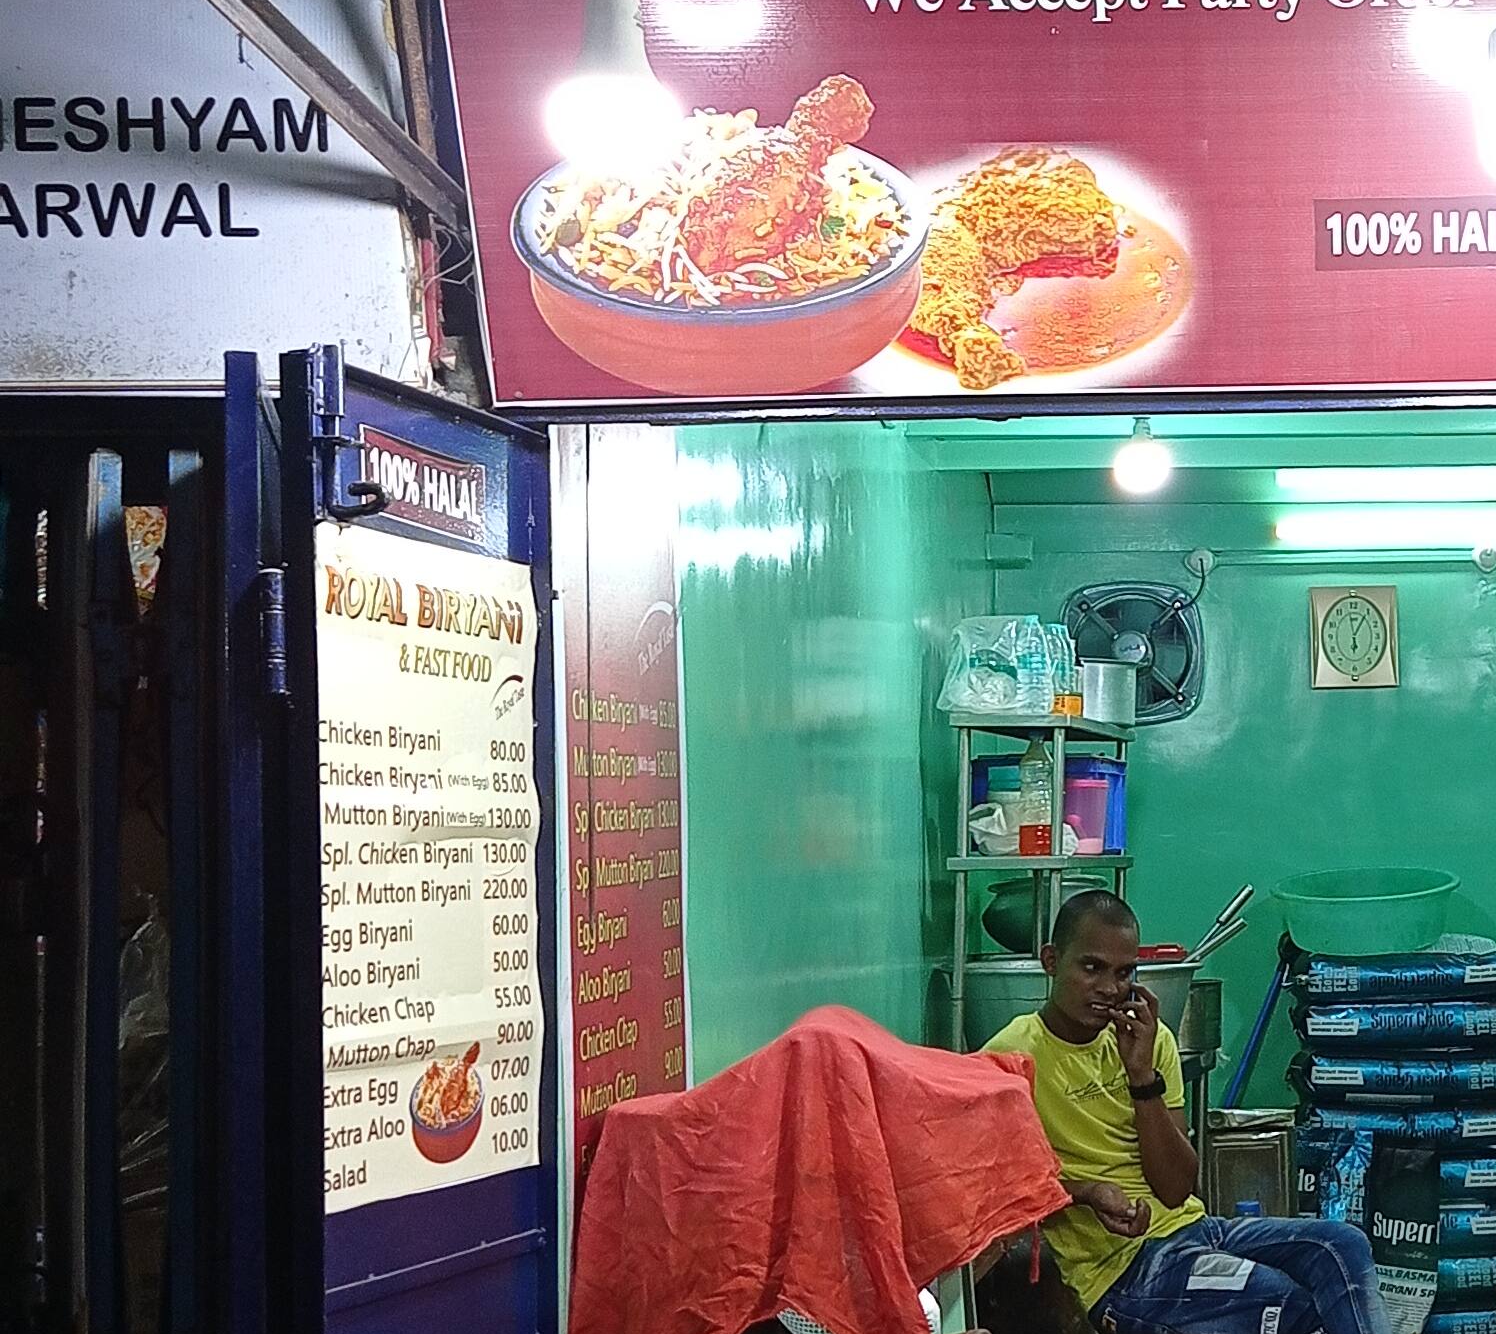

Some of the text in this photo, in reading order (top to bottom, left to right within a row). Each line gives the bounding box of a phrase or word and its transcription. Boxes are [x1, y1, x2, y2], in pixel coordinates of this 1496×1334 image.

[0, 96, 329, 153] ESHYAM
[1325, 210, 1422, 257] 100%
[368, 446, 482, 527] 100% HALAL
[324, 564, 525, 645] ROYAL BIRYANI
[399, 643, 493, 683] & FAST FOOD
[318, 719, 527, 763] Chicken Biryani 80.00
[318, 761, 384, 787] Chicken
[389, 765, 444, 795] Biryani
[491, 771, 528, 794] 85.00
[323, 801, 388, 827] Mutton
[391, 804, 446, 833] Biryani
[487, 807, 532, 829] 130.00
[321, 840, 528, 872] Spl. Chicken Biryani 130.00
[320, 877, 529, 913] Spl. Mutton Biryani 220.00
[321, 913, 529, 954] Egg Biryani 60.00
[322, 948, 530, 990] Aloo Biryani 50.00
[321, 984, 532, 1030] Chicken Chap 55.00
[326, 1019, 534, 1069] Mutton Chap 90.00
[579, 1024, 616, 1062] Chicken
[323, 1055, 531, 1110] Extra Egg 07.00
[323, 1091, 529, 1152] Extra Aloo 06.00
[323, 1126, 529, 1194] Salad 10.00
[1373, 1211, 1436, 1246] Superr
